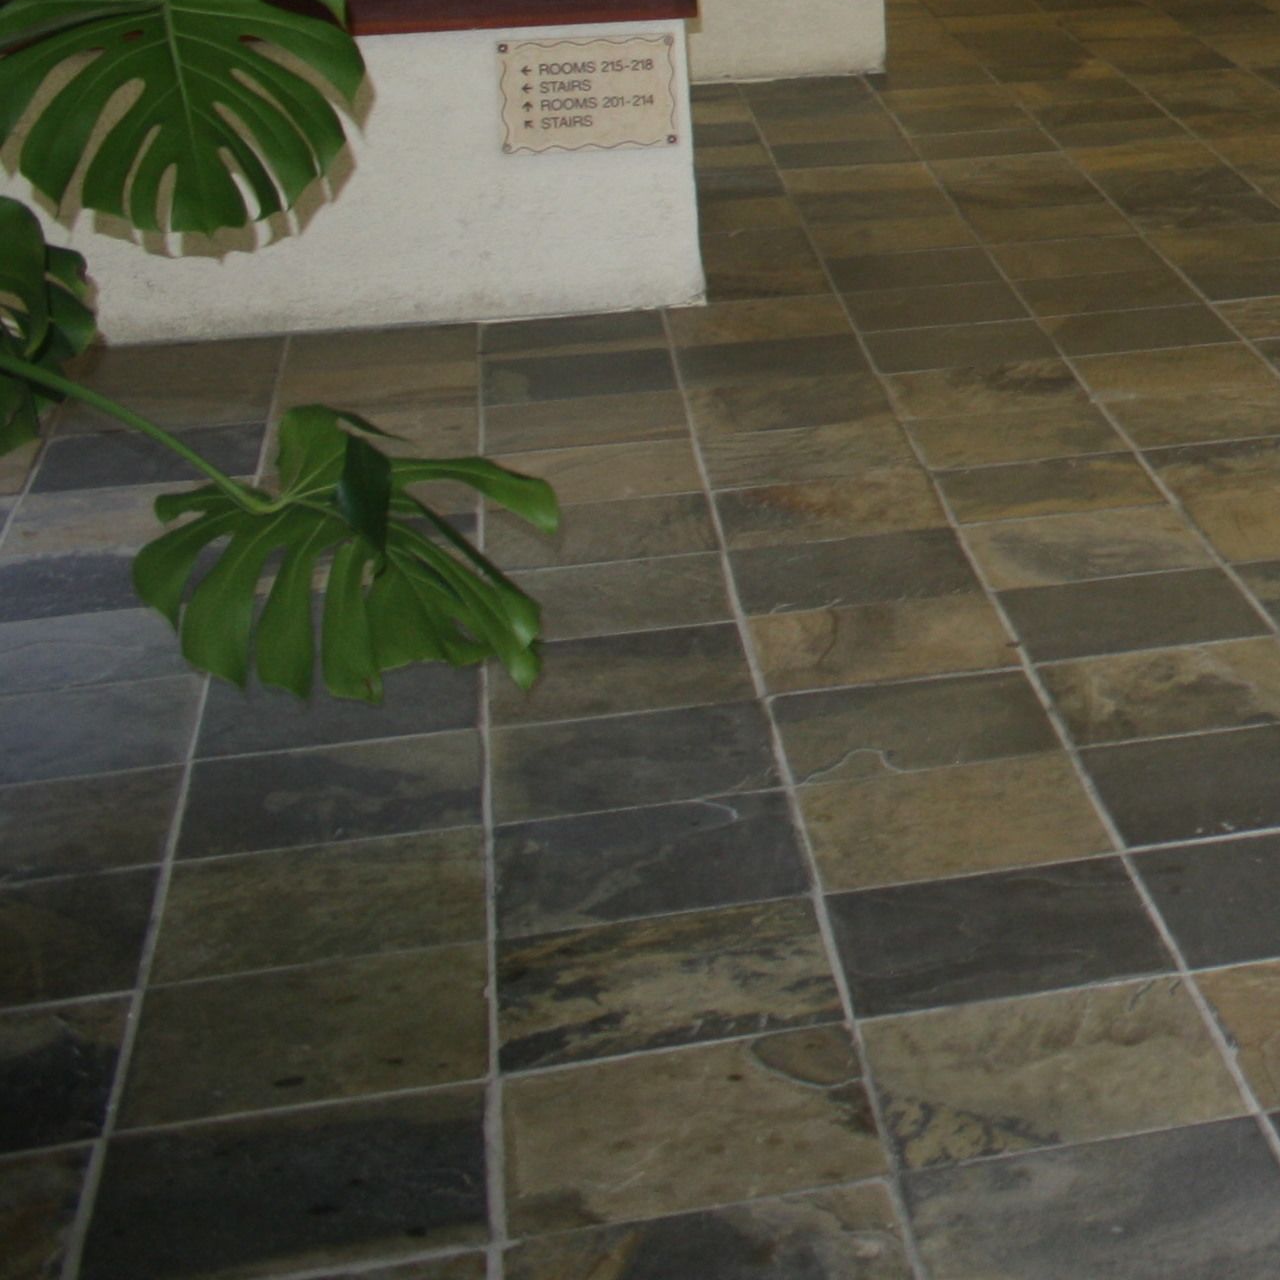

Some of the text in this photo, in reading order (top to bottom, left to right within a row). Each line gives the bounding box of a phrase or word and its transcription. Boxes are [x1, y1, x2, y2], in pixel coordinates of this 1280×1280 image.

[538, 58, 654, 76] ROOMS 215-218
[539, 79, 592, 94] STAIRS
[540, 94, 655, 112] ROOMS 201-214
[541, 115, 594, 130] STAIRS
